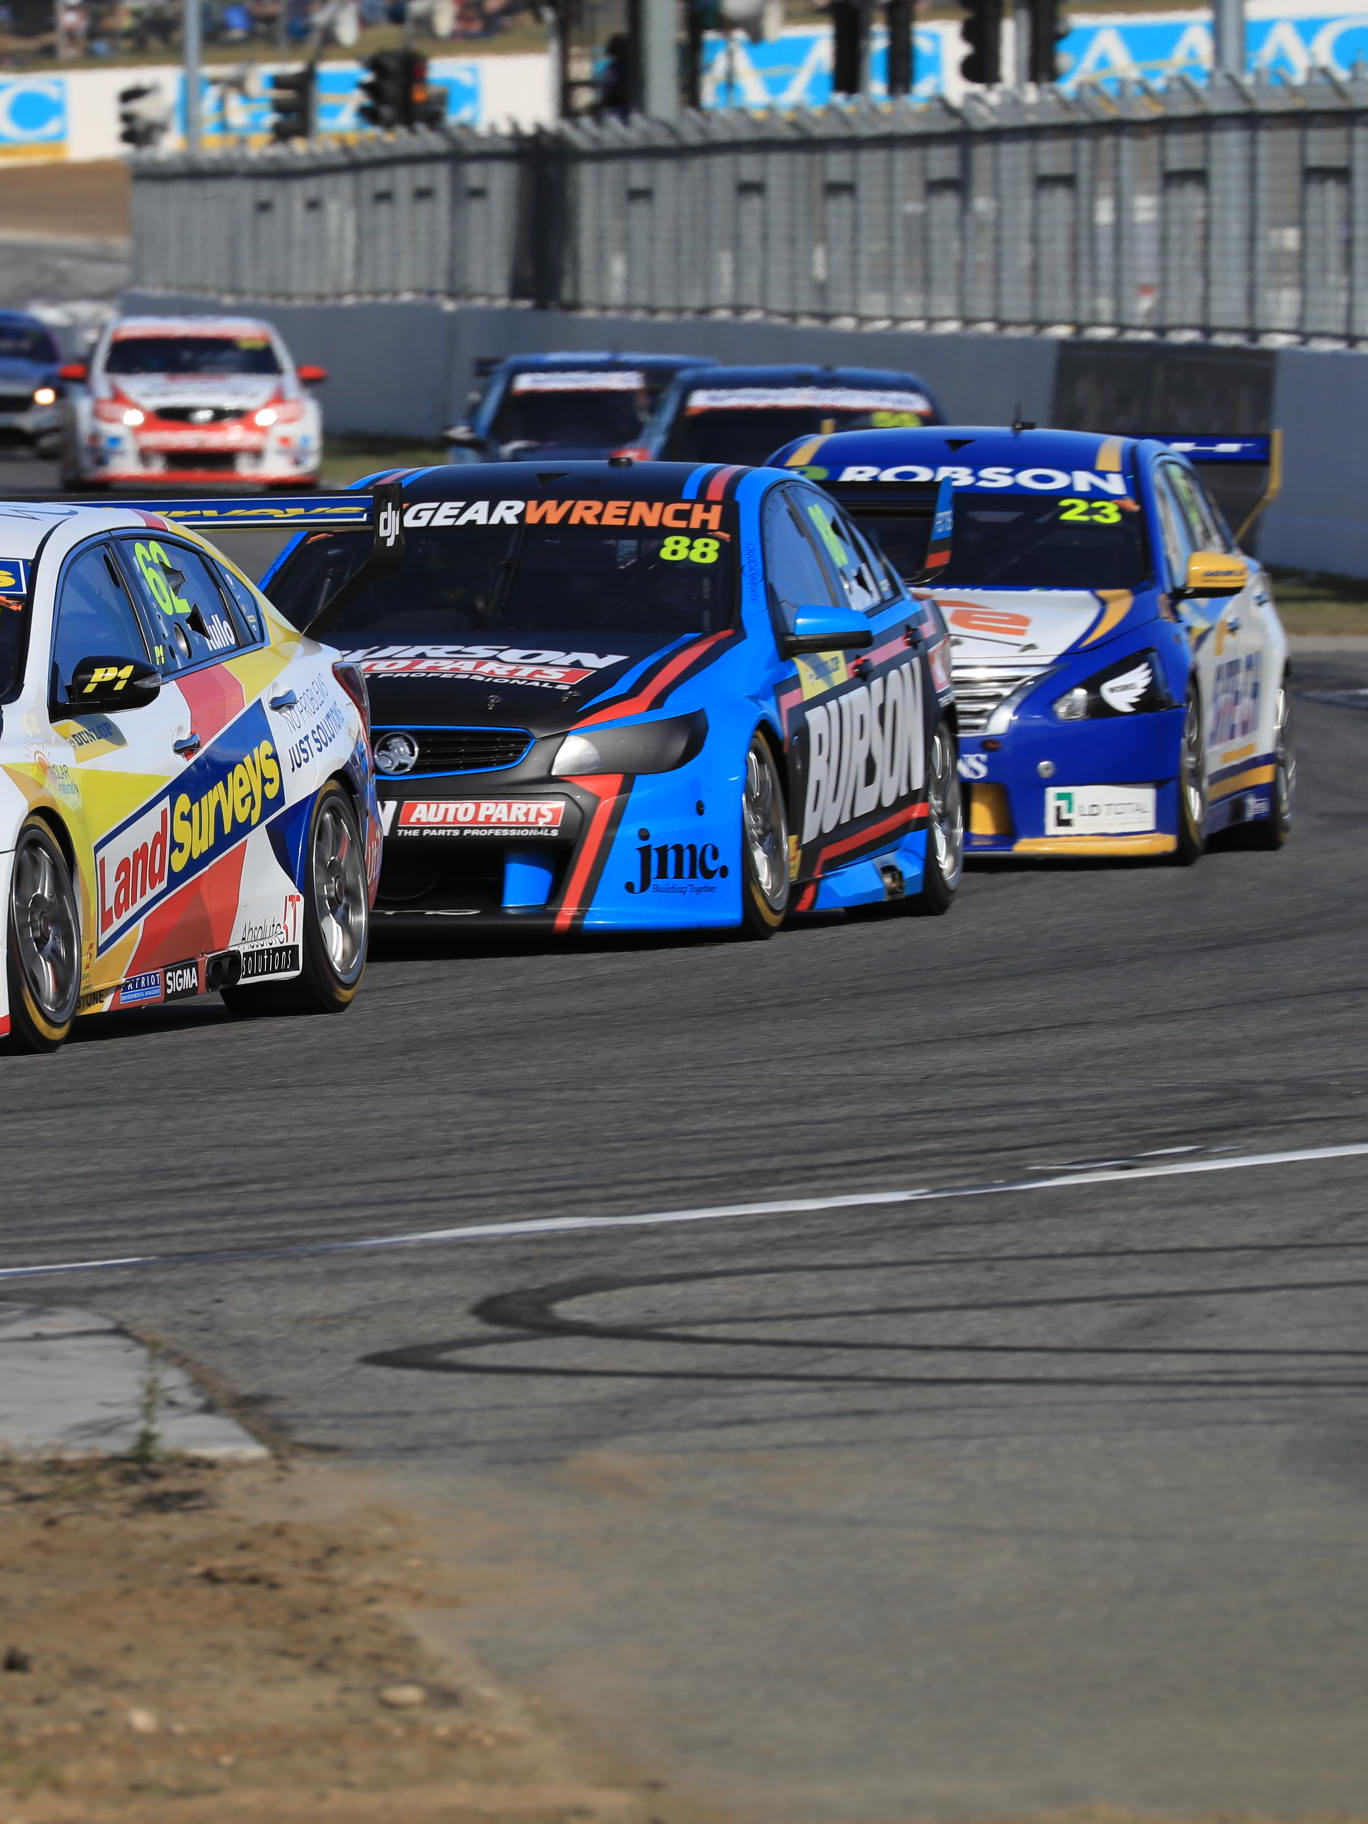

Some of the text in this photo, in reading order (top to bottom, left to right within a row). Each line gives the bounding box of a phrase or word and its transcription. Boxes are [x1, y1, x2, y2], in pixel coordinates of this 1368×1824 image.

[838, 465, 1127, 495] ROBSON
[403, 500, 723, 530] GEARWRENCH
[1058, 498, 1122, 524] 23
[659, 536, 720, 564] 88
[135, 540, 192, 616] 62
[82, 665, 134, 693] P1
[377, 673, 573, 691] PROFESSIONALS
[414, 660, 568, 681] PARTS
[71, 721, 113, 747] DUNLOP
[288, 733, 314, 773] JUST
[801, 656, 925, 846] BURSON
[410, 802, 476, 823] AUTO
[477, 802, 554, 823] PARTS
[98, 807, 168, 935] Land
[170, 740, 280, 873] Surveys
[397, 828, 559, 837] THE PARTS PROFESSIONALS
[624, 827, 729, 895] jmc.
[242, 949, 292, 976] solutions
[166, 967, 198, 994] SIGMA
